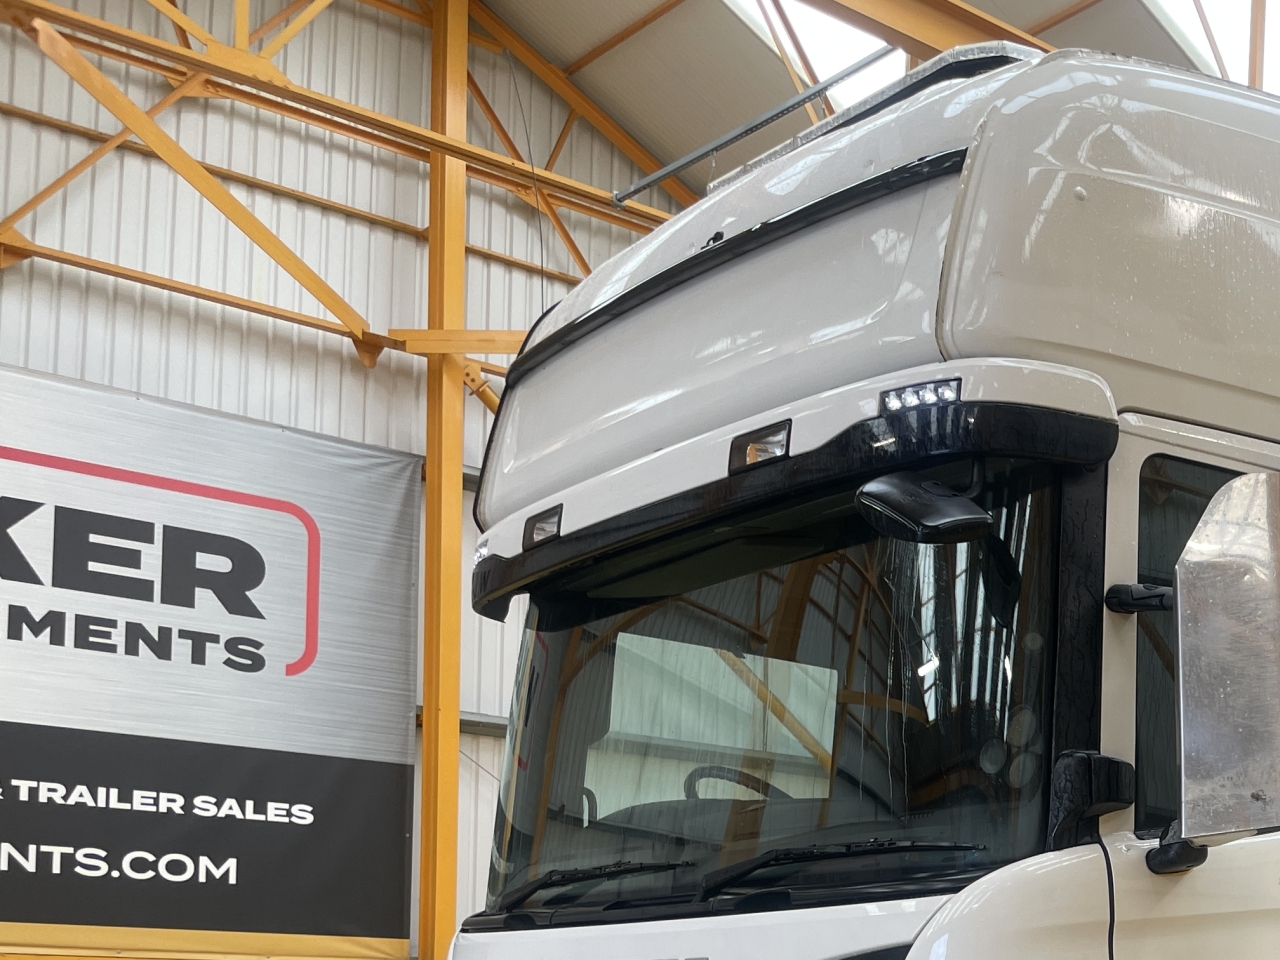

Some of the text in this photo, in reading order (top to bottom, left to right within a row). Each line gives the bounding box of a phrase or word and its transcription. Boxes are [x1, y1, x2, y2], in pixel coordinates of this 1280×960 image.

[7, 604, 267, 673] MENTS
[11, 779, 185, 814] TRAILER
[192, 796, 315, 825] SALES
[0, 842, 238, 885] NTS.COM
